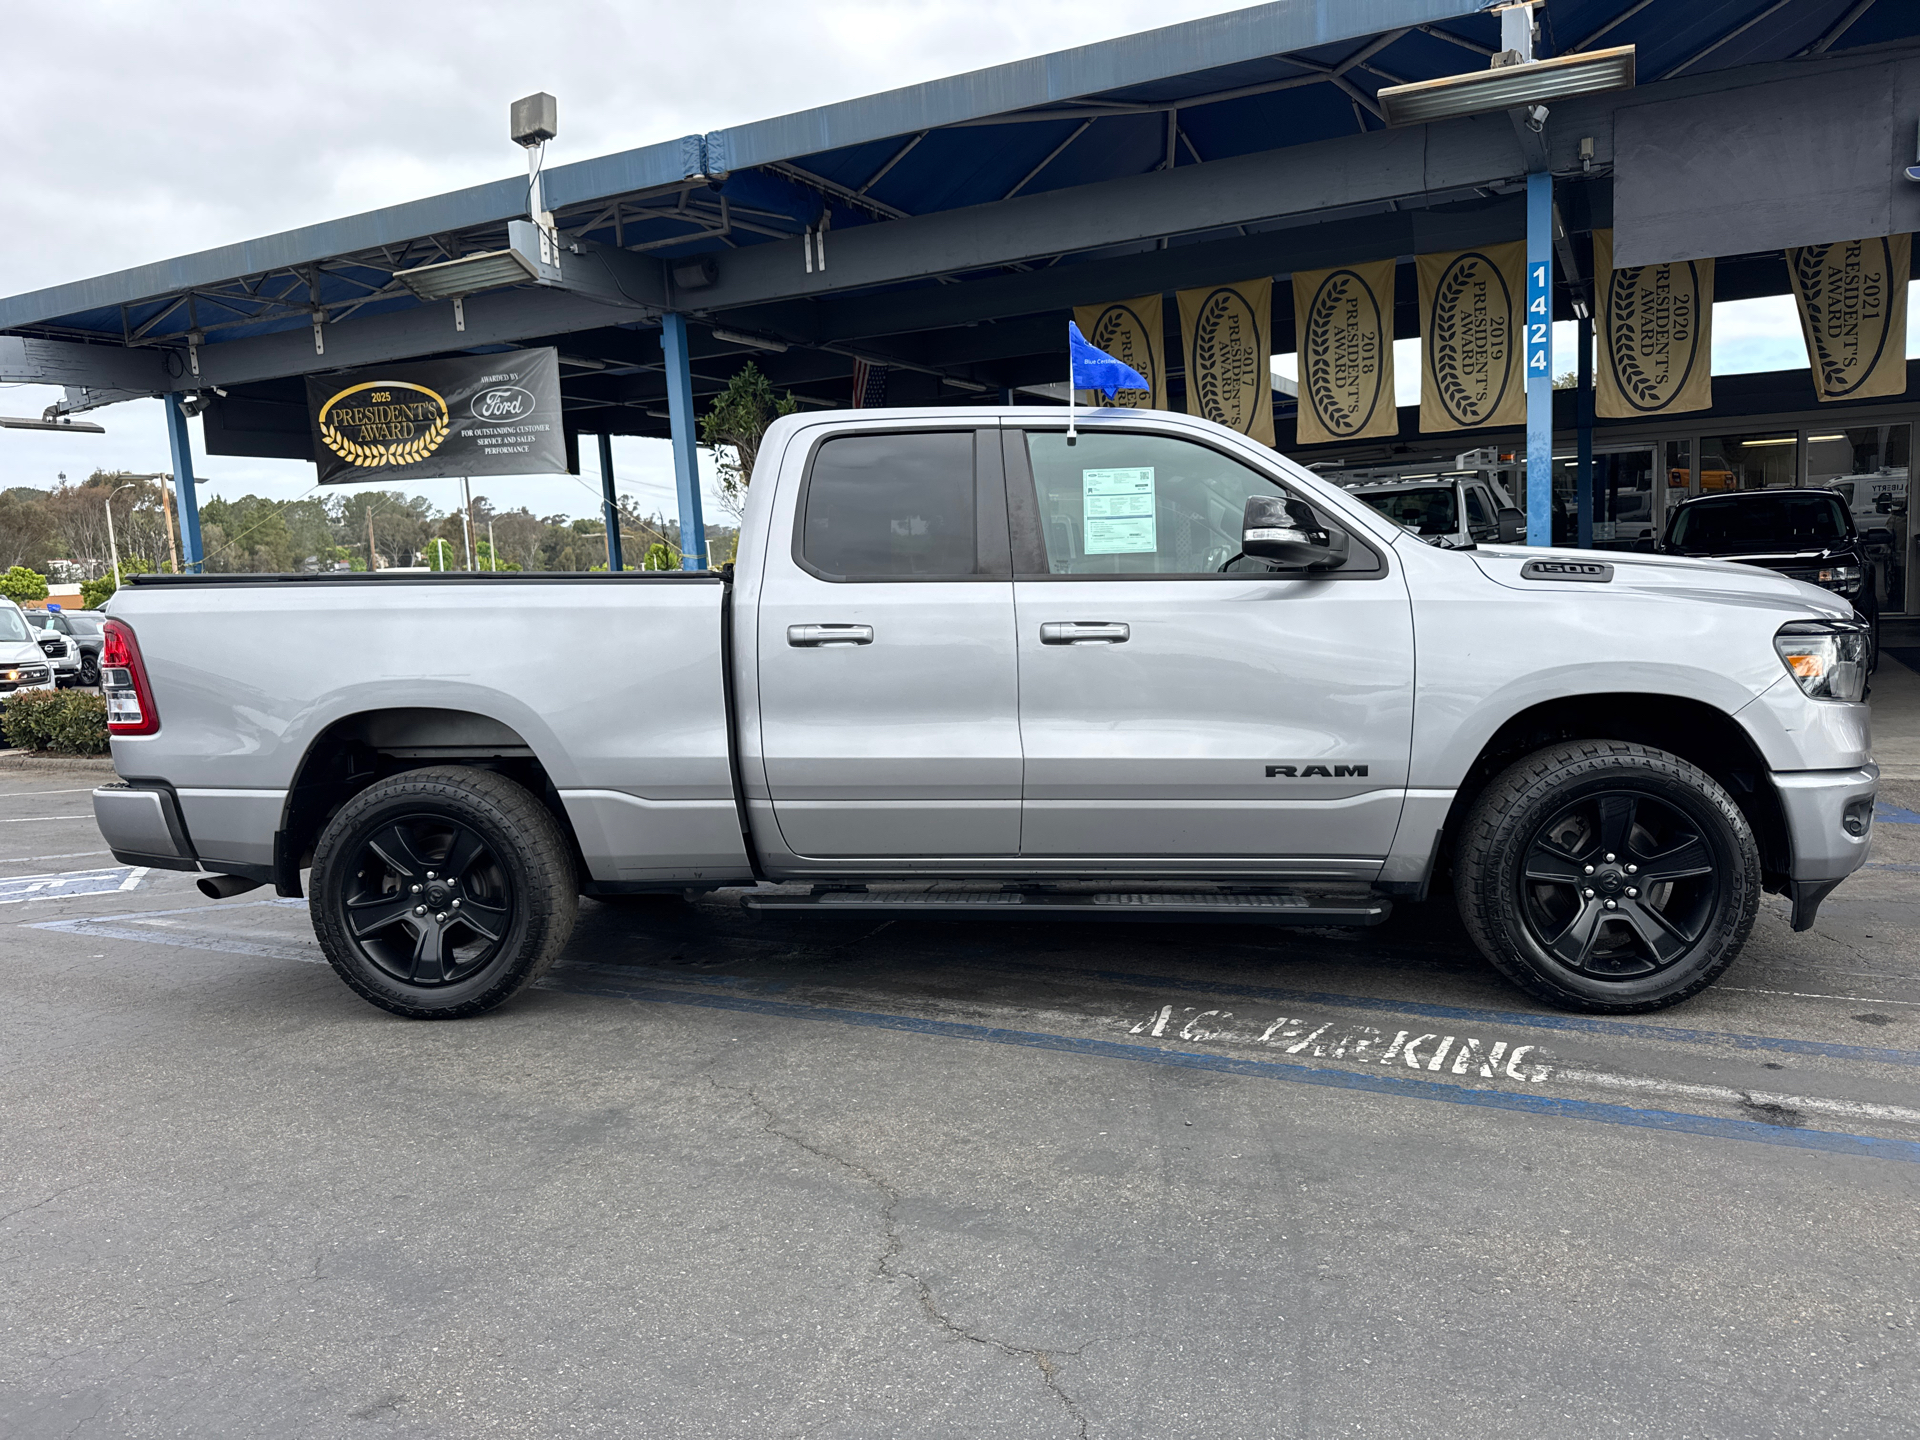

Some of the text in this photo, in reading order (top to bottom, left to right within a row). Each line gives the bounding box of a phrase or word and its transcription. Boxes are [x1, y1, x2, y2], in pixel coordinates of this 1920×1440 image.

[1529, 266, 1547, 370] 1424
[1672, 293, 1690, 341] 2020
[1828, 266, 1843, 338] AWARD
[1861, 272, 1881, 320] 2021
[1460, 310, 1475, 376] AWARD
[1473, 280, 1488, 401] PRESIDENT'S
[1490, 316, 1505, 361] 2019
[1641, 287, 1655, 357] AWARD
[1218, 341, 1232, 401] AWARD
[1227, 313, 1242, 425] PRESIDENT'S
[1242, 346, 1254, 387] 2017
[1334, 325, 1347, 389] AWARD
[1346, 296, 1360, 414] PRESIDENT'S
[1361, 331, 1375, 374] 2018
[371, 392, 391, 403] 2025
[481, 372, 519, 384] AWARDED BY
[332, 401, 438, 427] PRESIDENT'S
[482, 391, 523, 416] Ford
[358, 422, 415, 442] AWARD
[461, 424, 551, 437] FOR OUTSTANDING CUSTOMER
[477, 435, 536, 446] SERVICE AND SALES
[484, 445, 530, 455] PERFORMANCE
[1531, 563, 1601, 575] 1500
[1265, 765, 1369, 778] RAM
